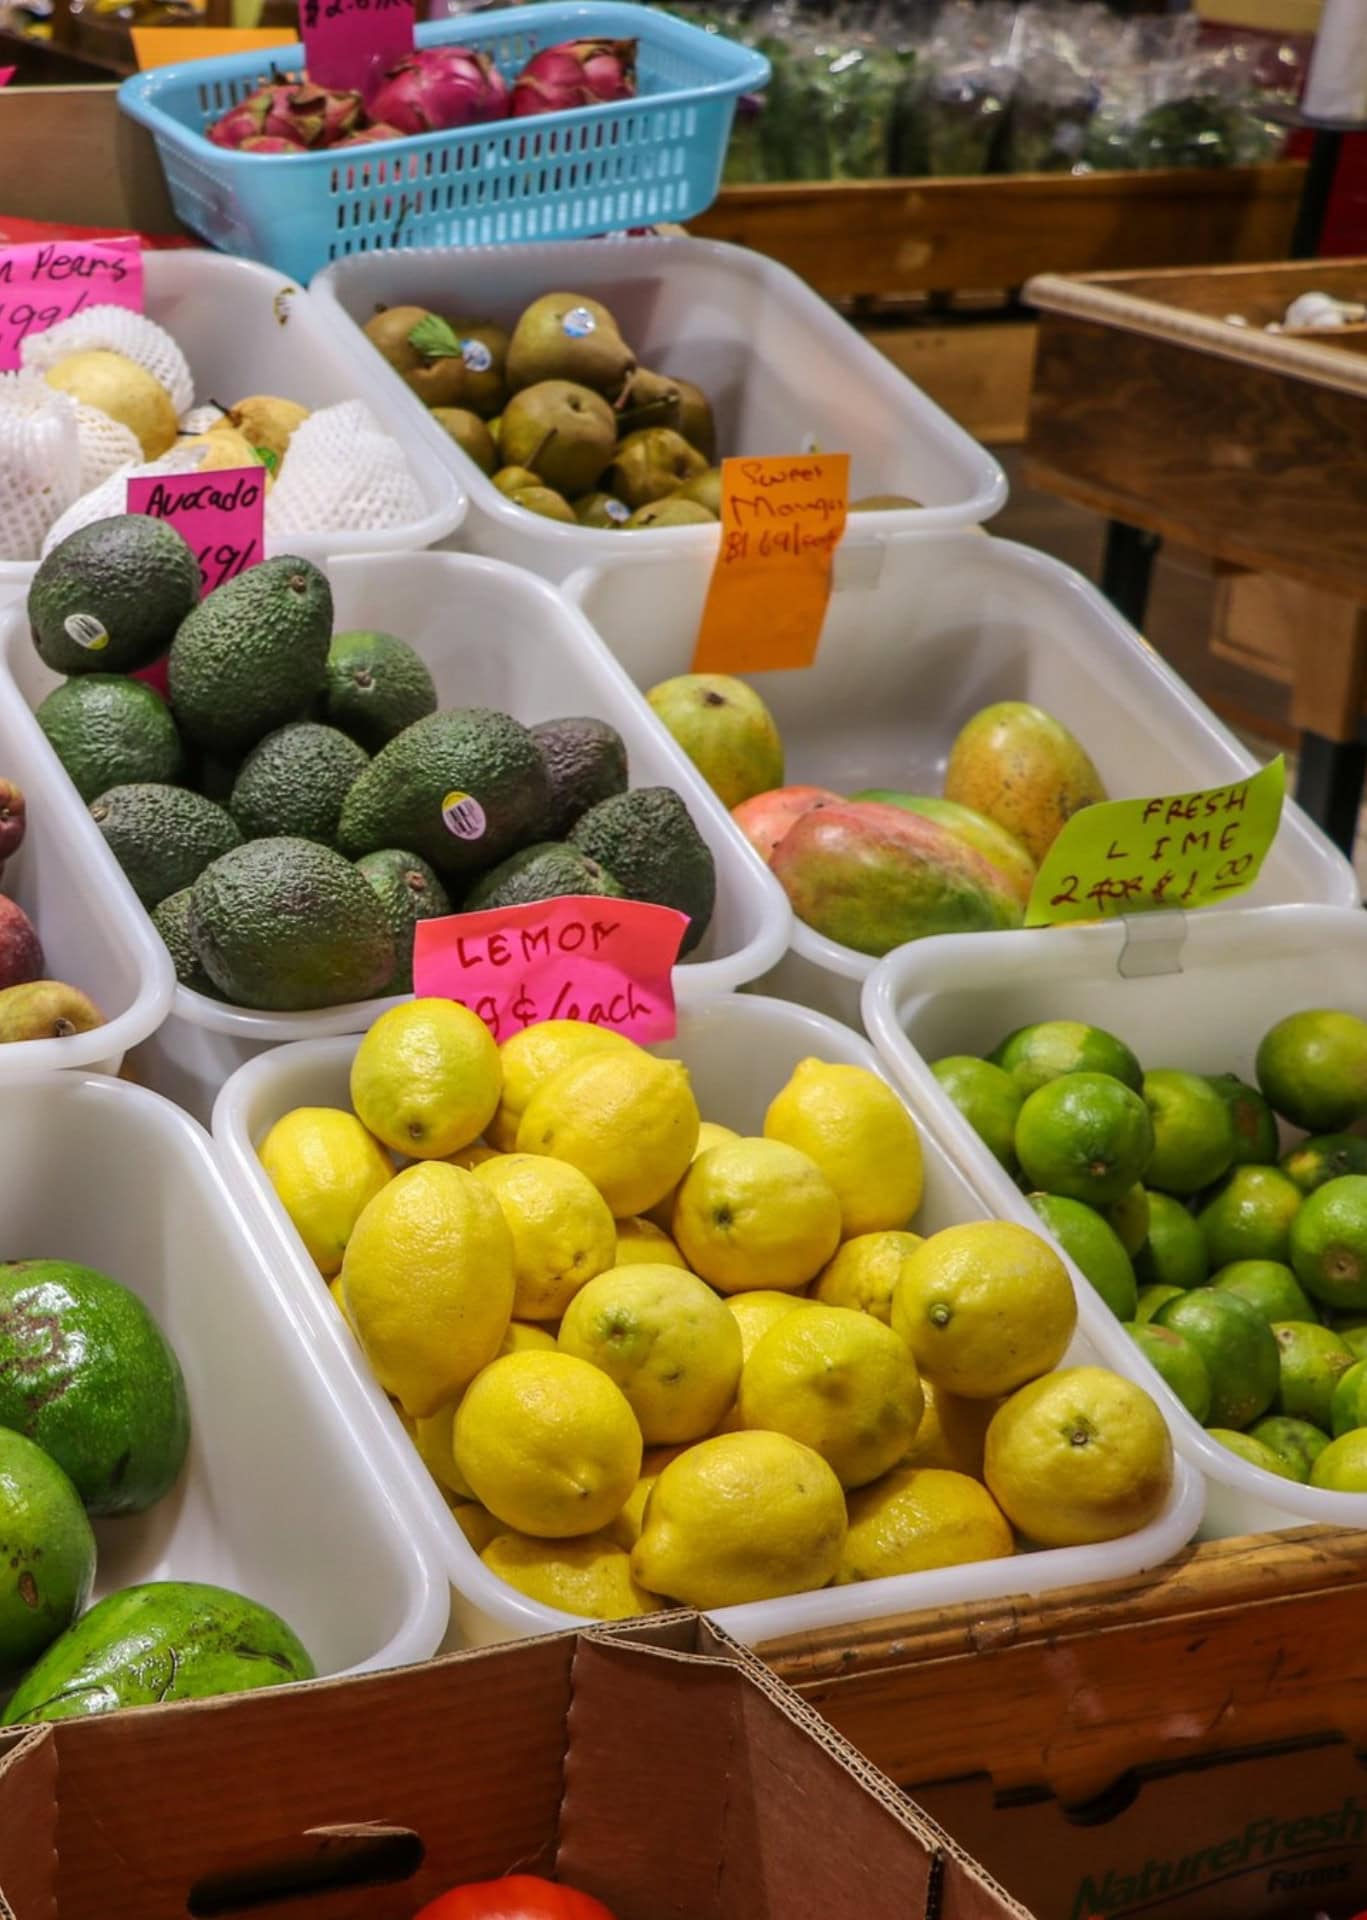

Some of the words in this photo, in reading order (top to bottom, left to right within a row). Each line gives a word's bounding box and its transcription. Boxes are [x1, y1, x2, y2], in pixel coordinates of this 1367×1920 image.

[32, 244, 128, 282] Pears
[145, 478, 259, 518] Avocado
[1142, 788, 1248, 824] FRESH
[1106, 823, 1240, 861] LIME
[1050, 875, 1079, 906] 2
[457, 922, 621, 969] LEMON
[1266, 1861, 1352, 1893] Farms
